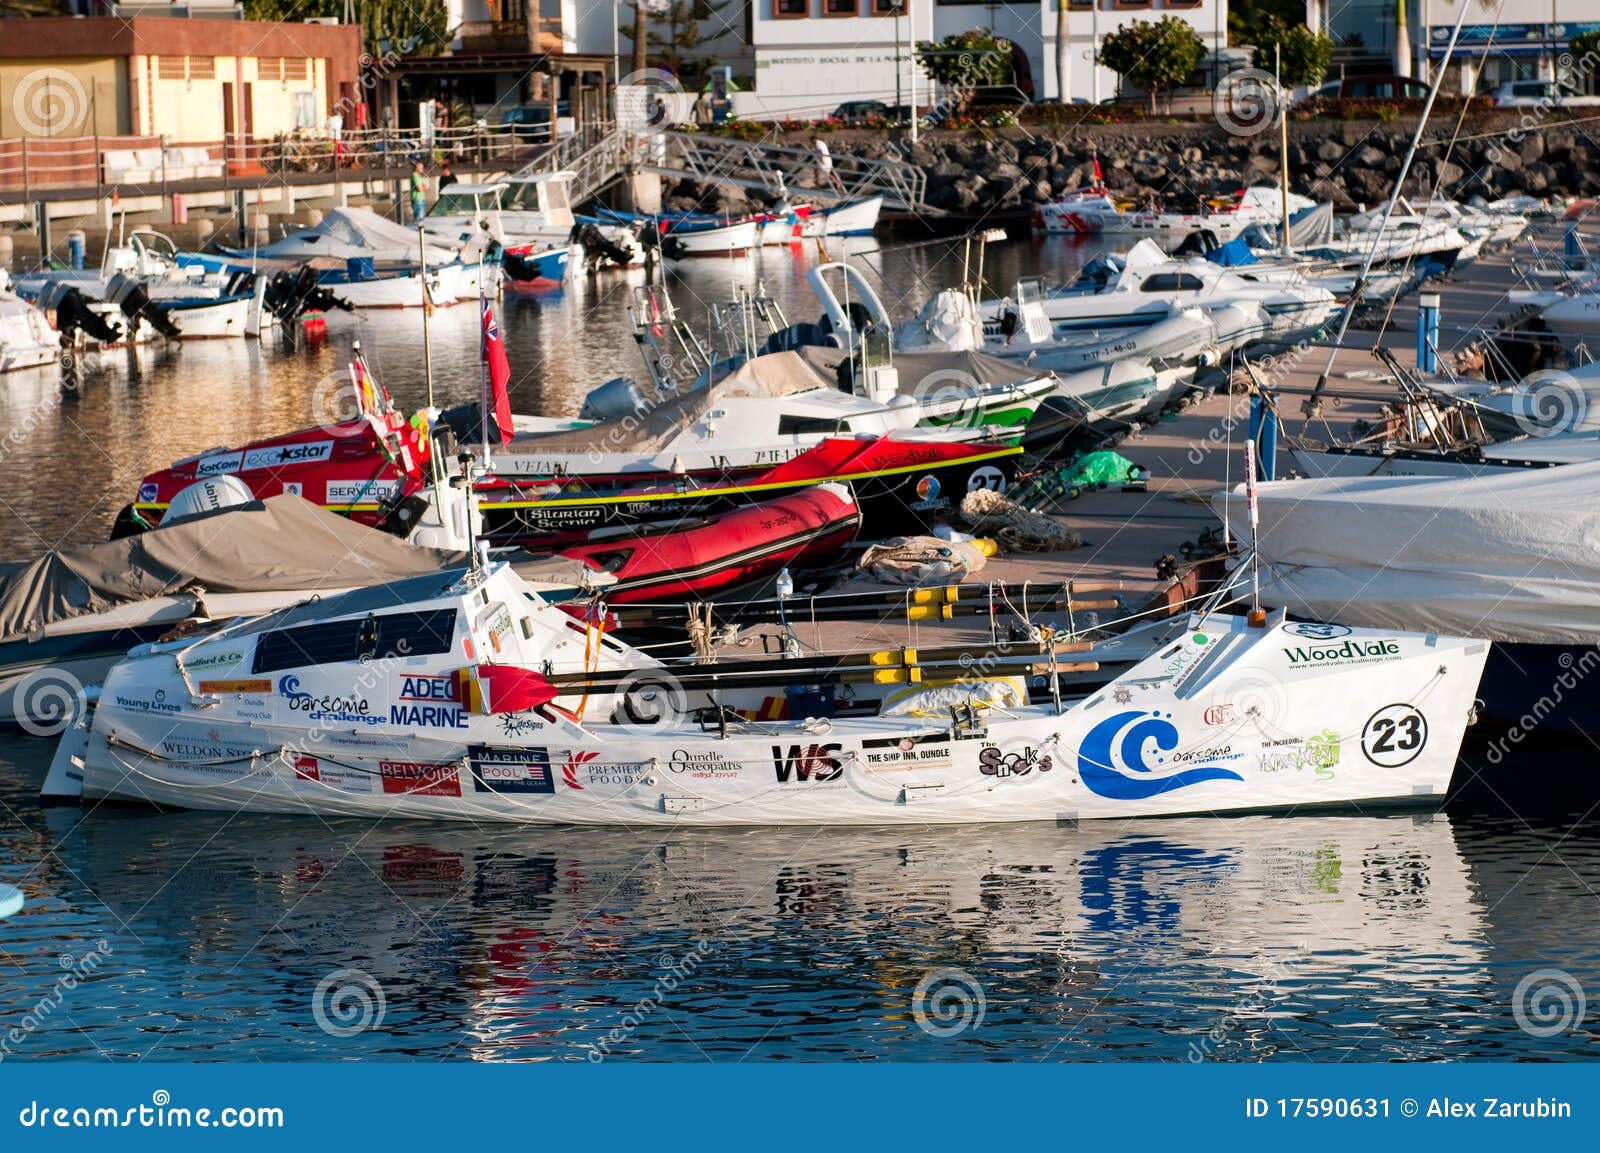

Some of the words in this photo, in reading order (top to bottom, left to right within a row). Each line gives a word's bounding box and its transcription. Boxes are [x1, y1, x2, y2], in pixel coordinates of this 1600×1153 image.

[116, 696, 149, 711] Young
[151, 701, 182, 712] Lives
[309, 710, 388, 726] challenge
[390, 705, 469, 729] MARINE
[1371, 714, 1421, 754] 23
[163, 742, 222, 758] WELDON
[867, 753, 882, 763] THE
[883, 752, 900, 762] SHIP
[920, 749, 950, 759] OUNDLE
[482, 767, 520, 778] POOL
[589, 764, 643, 775] PREMIER
[590, 775, 645, 784] FOODS
